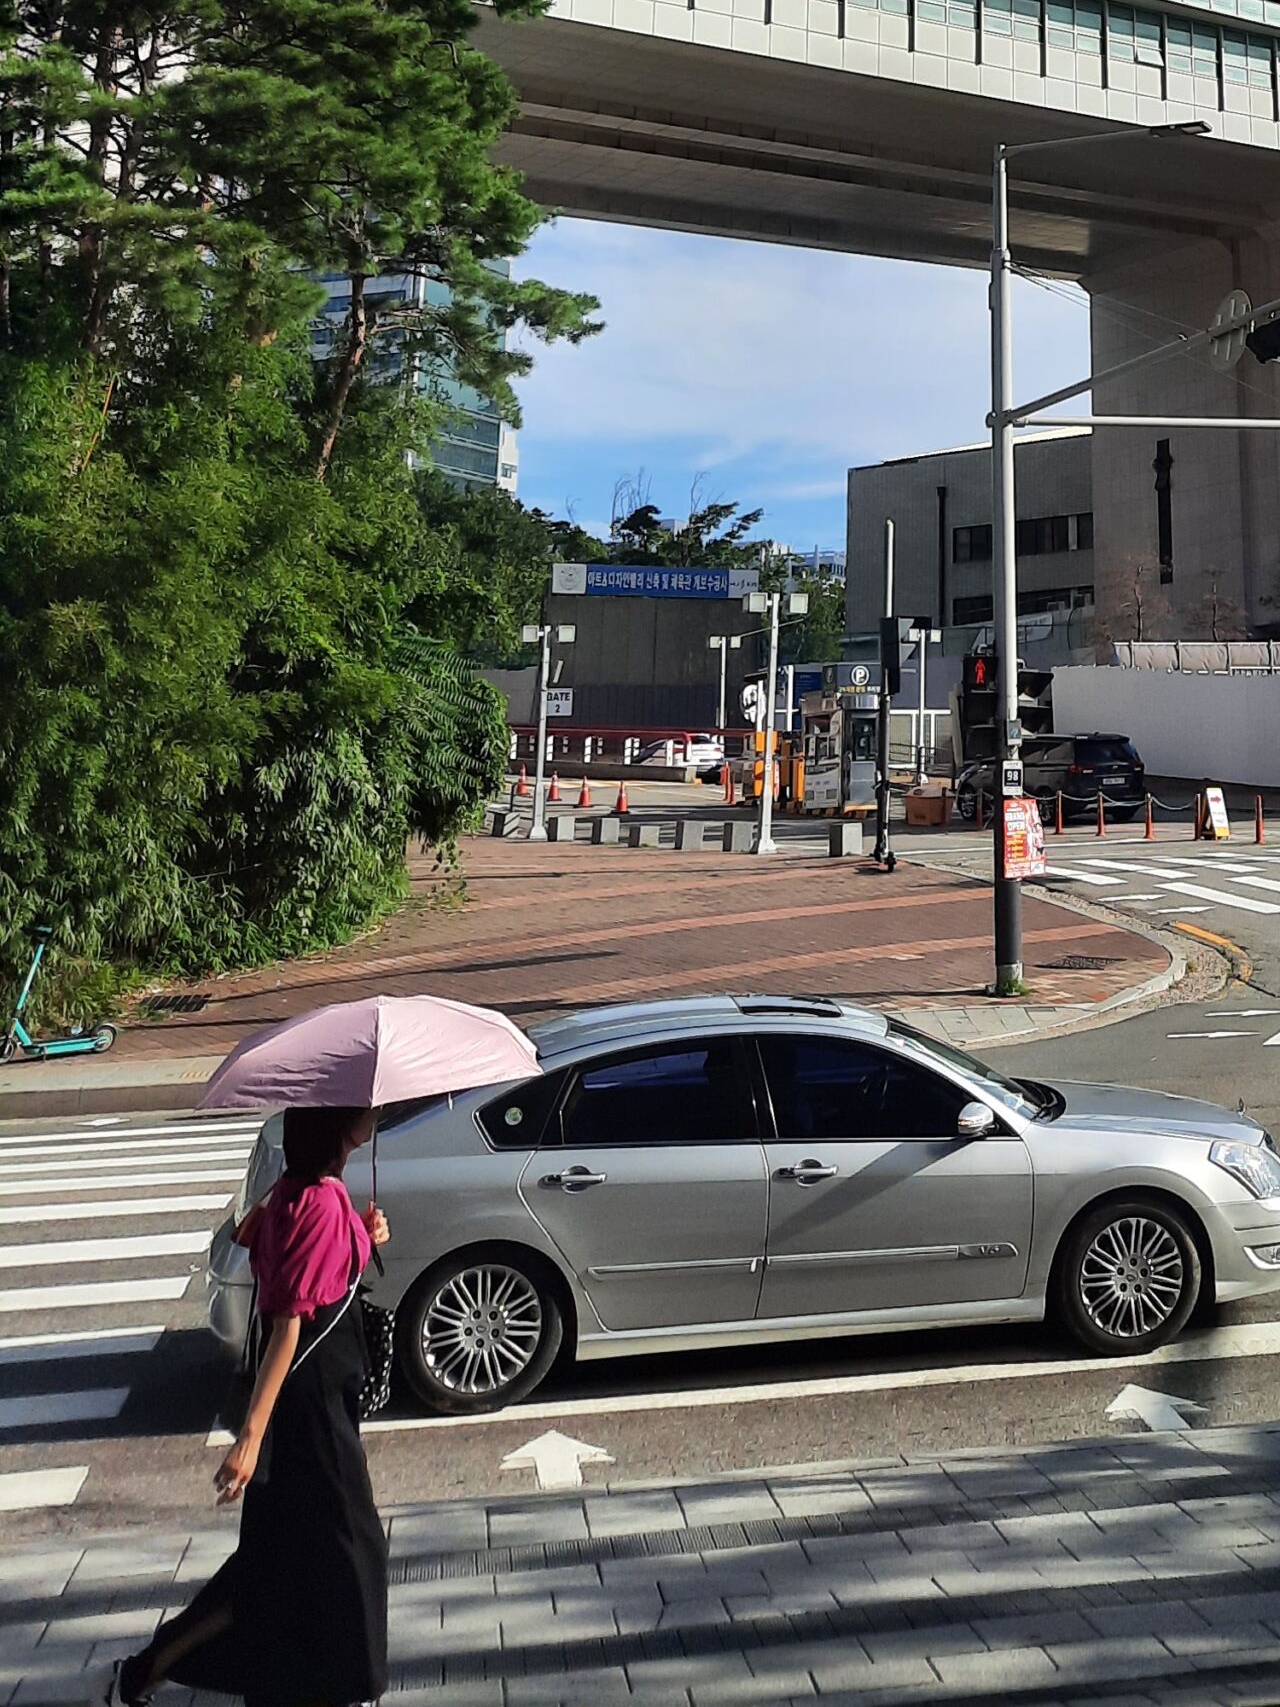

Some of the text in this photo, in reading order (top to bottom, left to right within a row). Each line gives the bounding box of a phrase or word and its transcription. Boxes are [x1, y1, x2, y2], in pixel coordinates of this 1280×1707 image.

[547, 691, 571, 702] GATE
[555, 704, 561, 714] 2
[1007, 770, 1019, 781] 98
[980, 1245, 1000, 1255] V6
